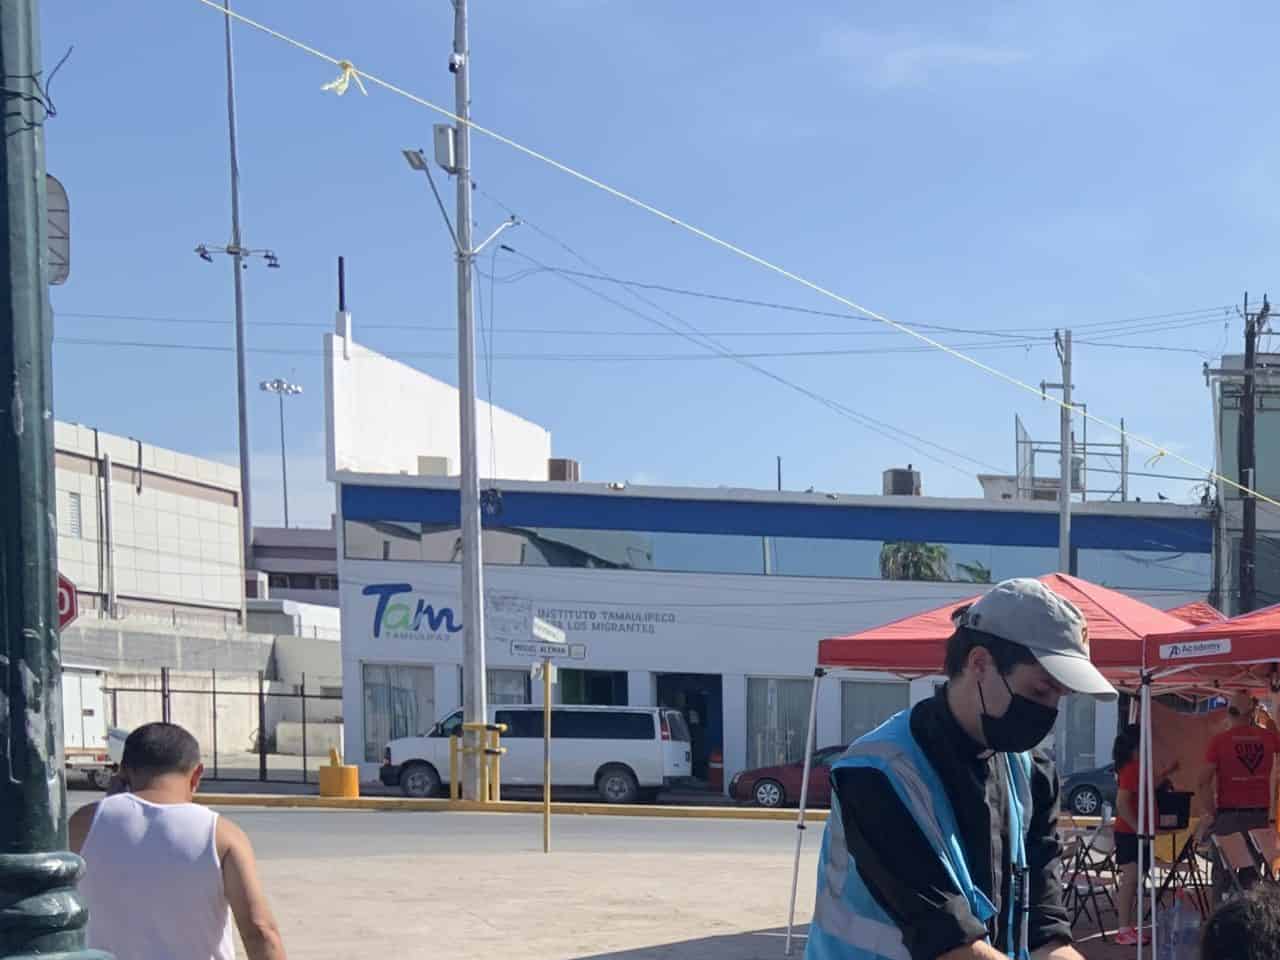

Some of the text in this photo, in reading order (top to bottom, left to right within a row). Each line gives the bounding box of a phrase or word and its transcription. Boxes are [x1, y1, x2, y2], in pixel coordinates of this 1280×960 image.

[537, 608, 677, 624] INSTITUTO TAMAULIPECO
[591, 622, 656, 634] MIGRANTES
